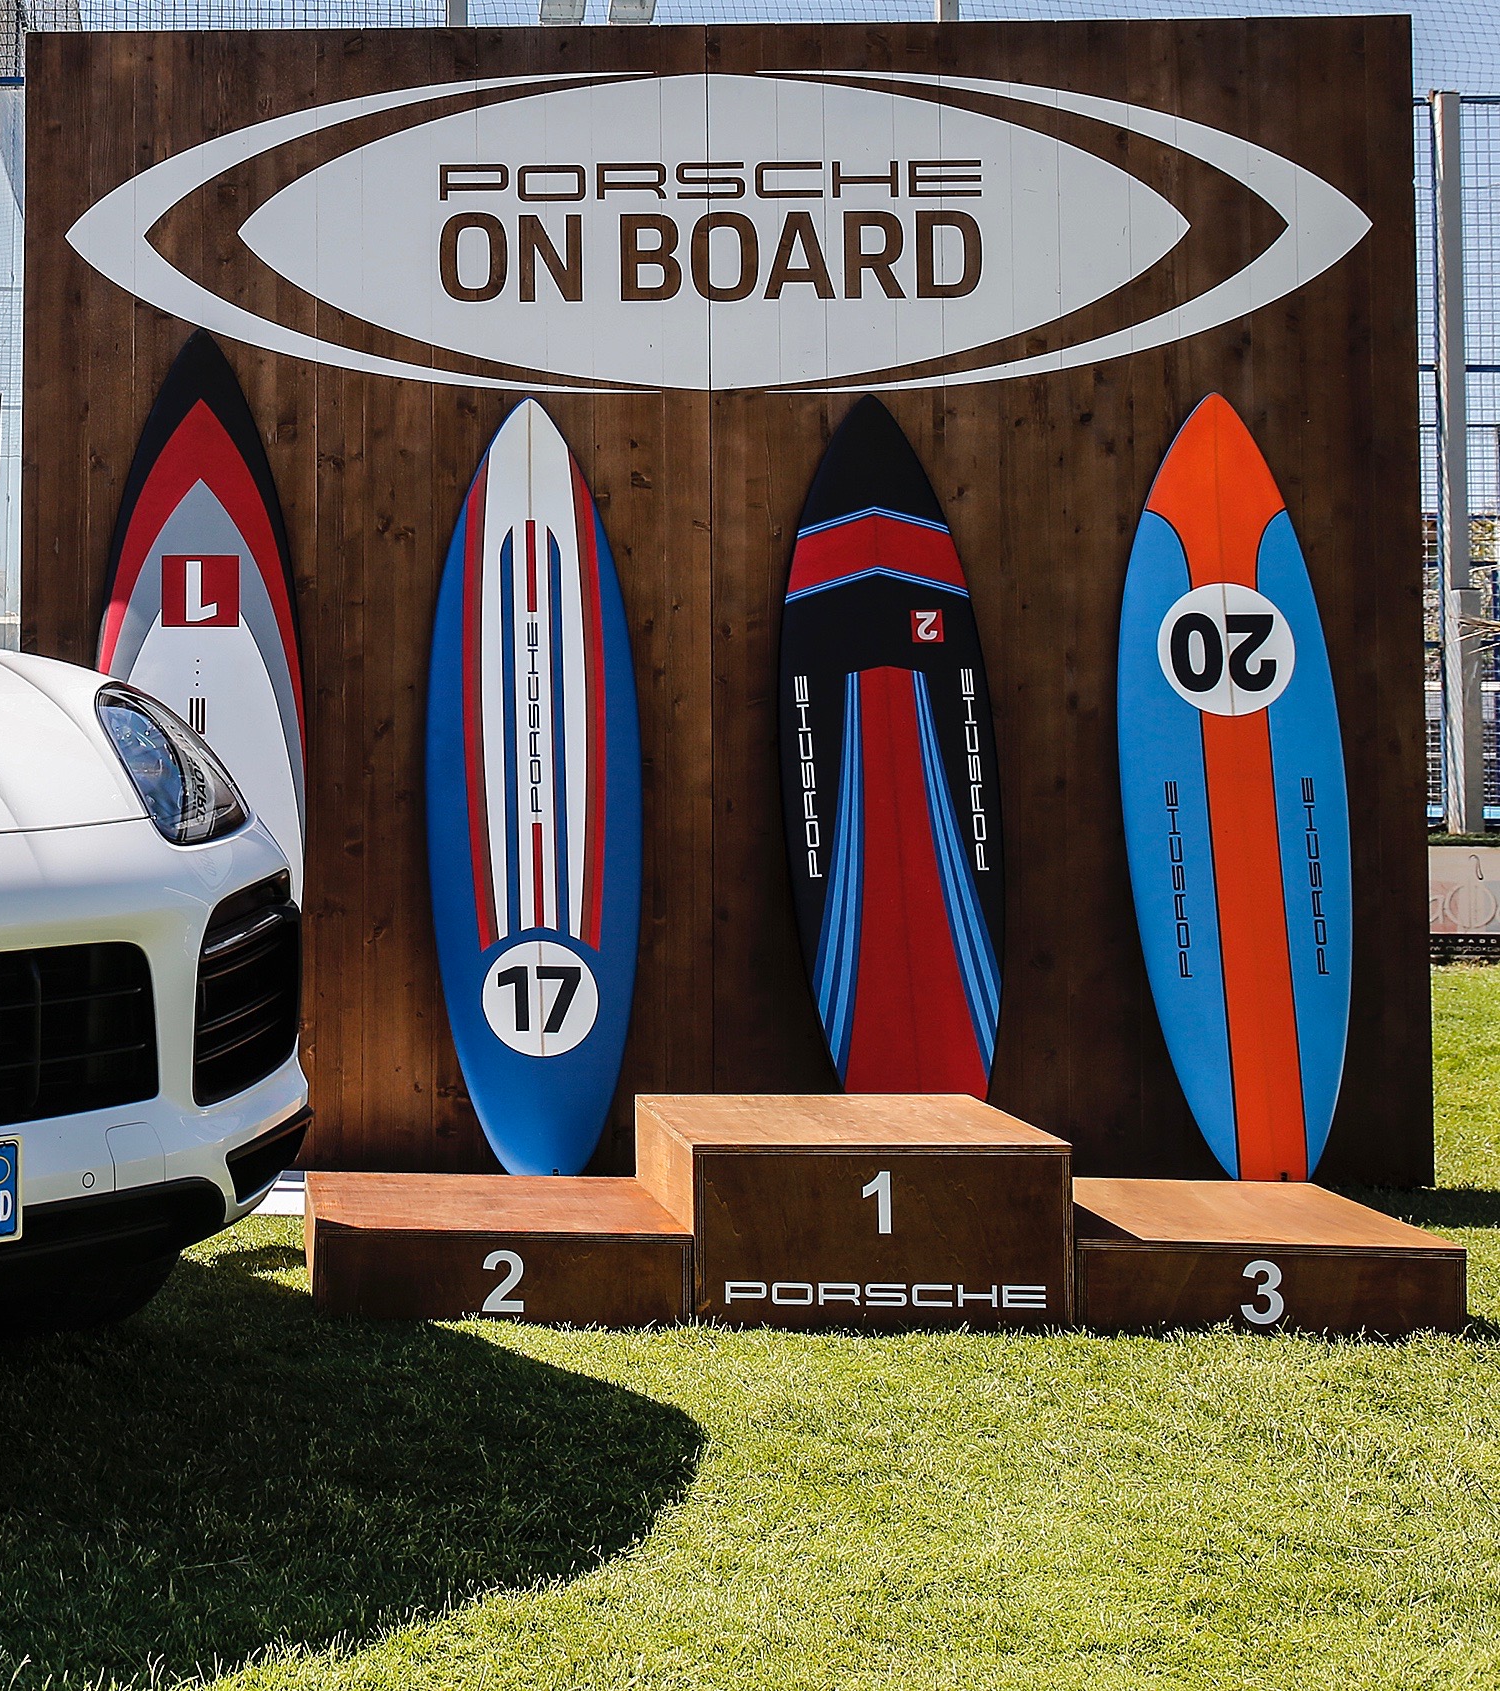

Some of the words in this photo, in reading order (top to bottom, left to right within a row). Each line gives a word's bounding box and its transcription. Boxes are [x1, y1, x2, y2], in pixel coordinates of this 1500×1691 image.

[439, 159, 982, 202] PORSCHE
[439, 210, 583, 303] ON
[620, 209, 982, 302] BOARD
[185, 559, 218, 623] 1
[915, 611, 938, 641] 2
[1170, 612, 1277, 693] 20
[527, 620, 543, 814] PORSCHE
[794, 675, 822, 878] PORSCHE
[960, 668, 990, 871] PORSCHE
[1164, 779, 1193, 979] PORSCHE
[1300, 776, 1330, 976] PORSCHE
[496, 964, 582, 1033] 17
[862, 1170, 892, 1234] 1
[481, 1249, 525, 1314] 2
[725, 1280, 1048, 1310] PORSCHE
[1239, 1259, 1285, 1325] 3
